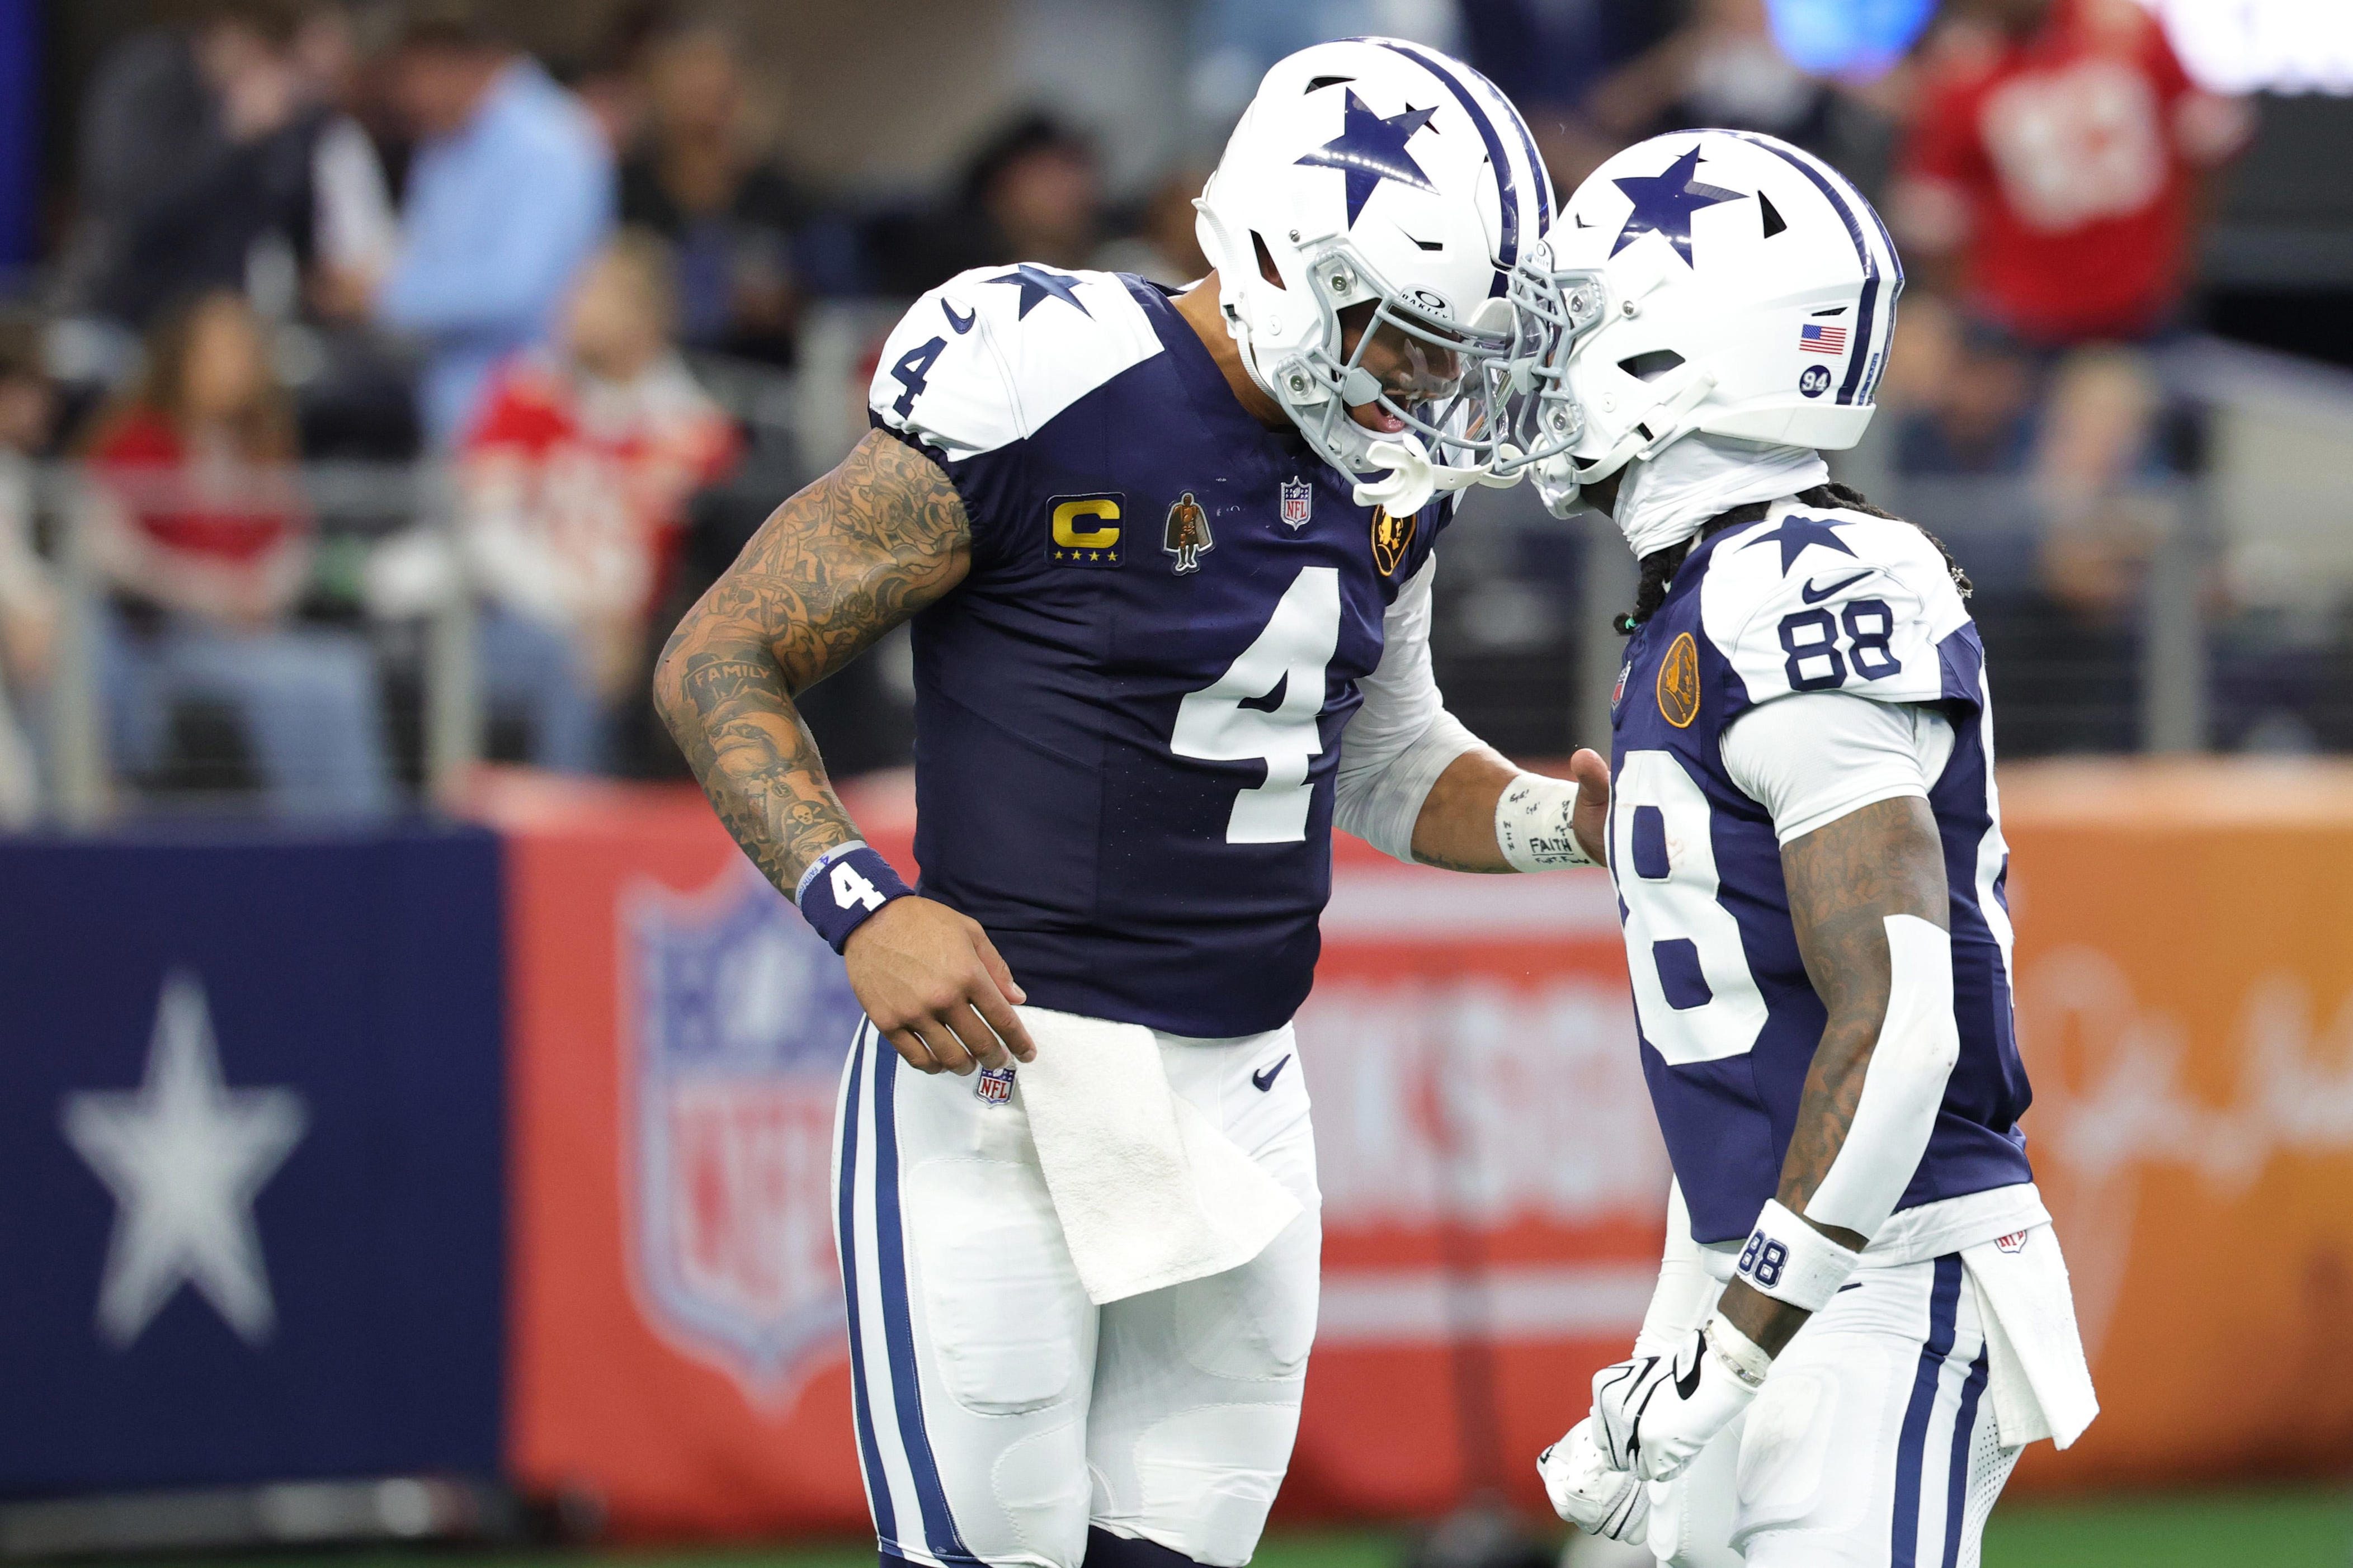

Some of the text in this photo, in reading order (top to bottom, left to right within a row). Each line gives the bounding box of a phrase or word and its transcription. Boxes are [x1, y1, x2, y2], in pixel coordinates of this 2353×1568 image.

[890, 336, 947, 421] 4
[1801, 371, 1828, 392] 94
[1052, 499, 1120, 548] C
[1286, 501, 1307, 519] NFL
[1777, 598, 1902, 692] 88
[695, 665, 770, 688] FAMILY
[1170, 566, 1341, 844] 4
[1530, 838, 1572, 853] FAITH
[829, 861, 886, 912] 4
[1604, 750, 1770, 1066] 8
[980, 1078, 1007, 1099] NFL
[1736, 1229, 1789, 1290] 88
